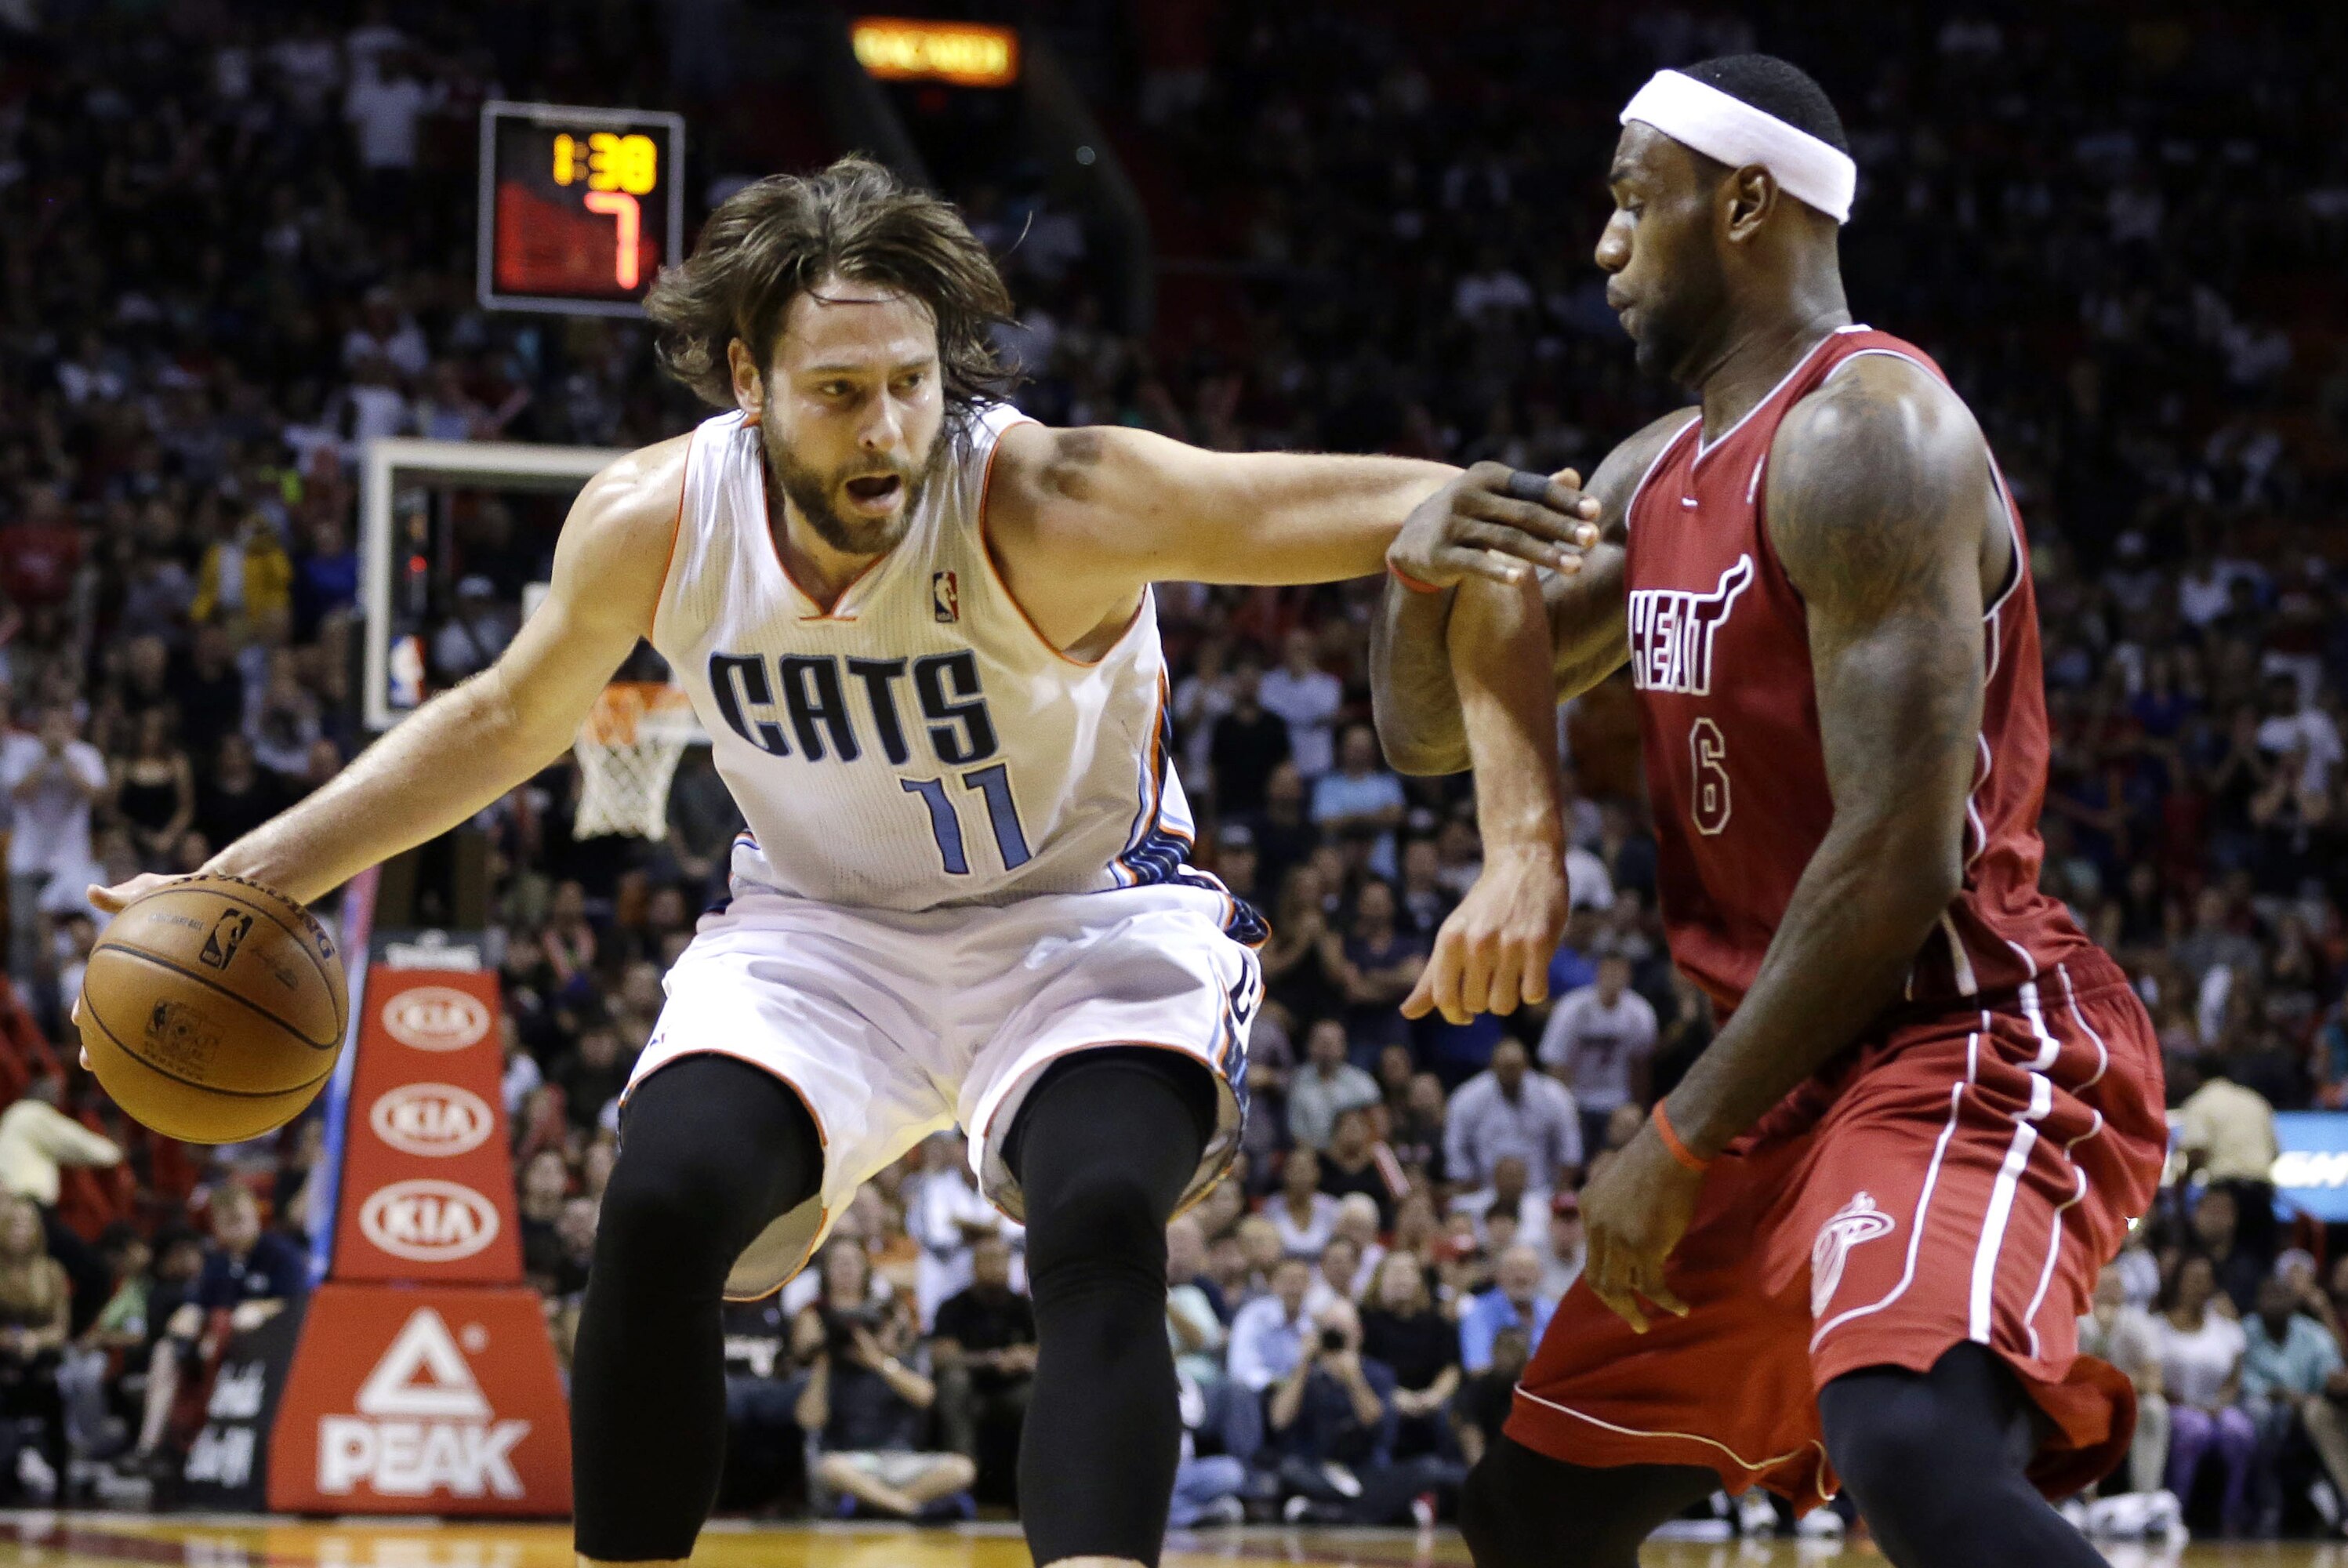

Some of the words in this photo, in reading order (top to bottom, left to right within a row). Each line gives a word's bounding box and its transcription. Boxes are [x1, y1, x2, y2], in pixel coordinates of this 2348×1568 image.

[553, 132, 657, 195] 1:38
[584, 191, 640, 289] 7
[1628, 554, 1755, 696] HEAT
[709, 648, 999, 766] CATS
[900, 763, 1033, 876] 11
[1689, 717, 1731, 835] 6
[401, 1000, 472, 1035] KIA
[391, 1099, 475, 1138] KIA
[384, 1197, 477, 1242] KIA
[316, 1414, 532, 1499] PEAK
